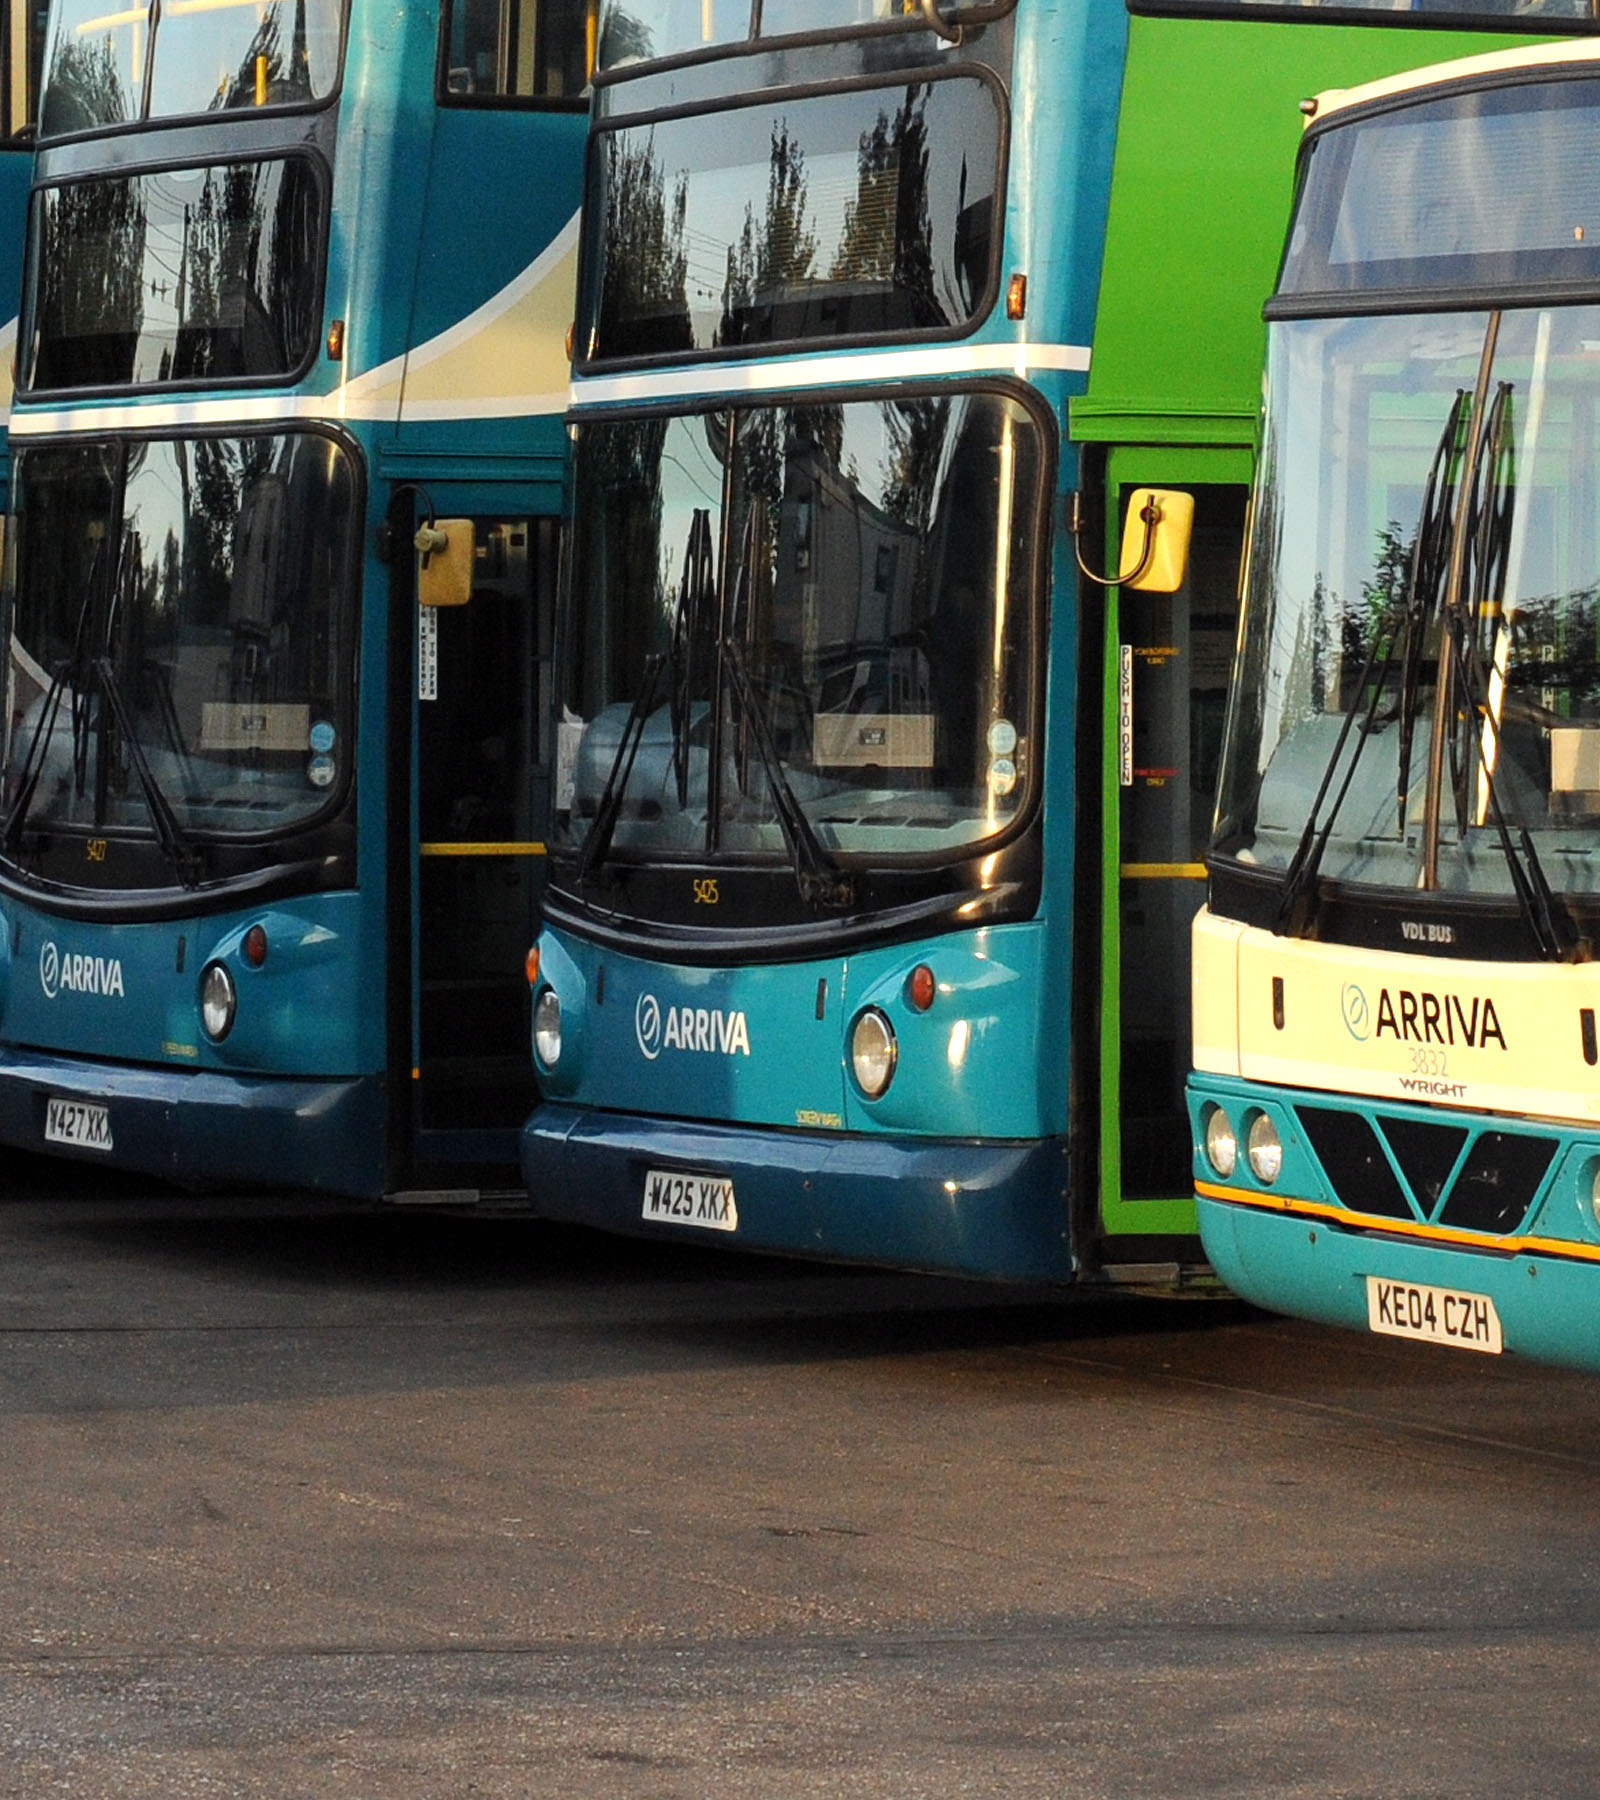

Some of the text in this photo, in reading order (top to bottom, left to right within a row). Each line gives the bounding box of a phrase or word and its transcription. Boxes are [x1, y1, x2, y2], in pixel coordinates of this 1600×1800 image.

[1121, 647, 1130, 782] PUSH TO OPEN
[693, 879, 719, 904] 5425
[1401, 921, 1452, 943] VDL BUS
[60, 953, 125, 998] ARRIVA
[664, 1006, 750, 1056] ARRIVA
[1376, 988, 1508, 1051] ARRIVA
[1408, 1047, 1449, 1078] 3832
[1399, 1077, 1468, 1098] WRIGHT
[650, 1176, 733, 1222] W425 XKX
[1377, 1282, 1490, 1342] KE04 CZH
